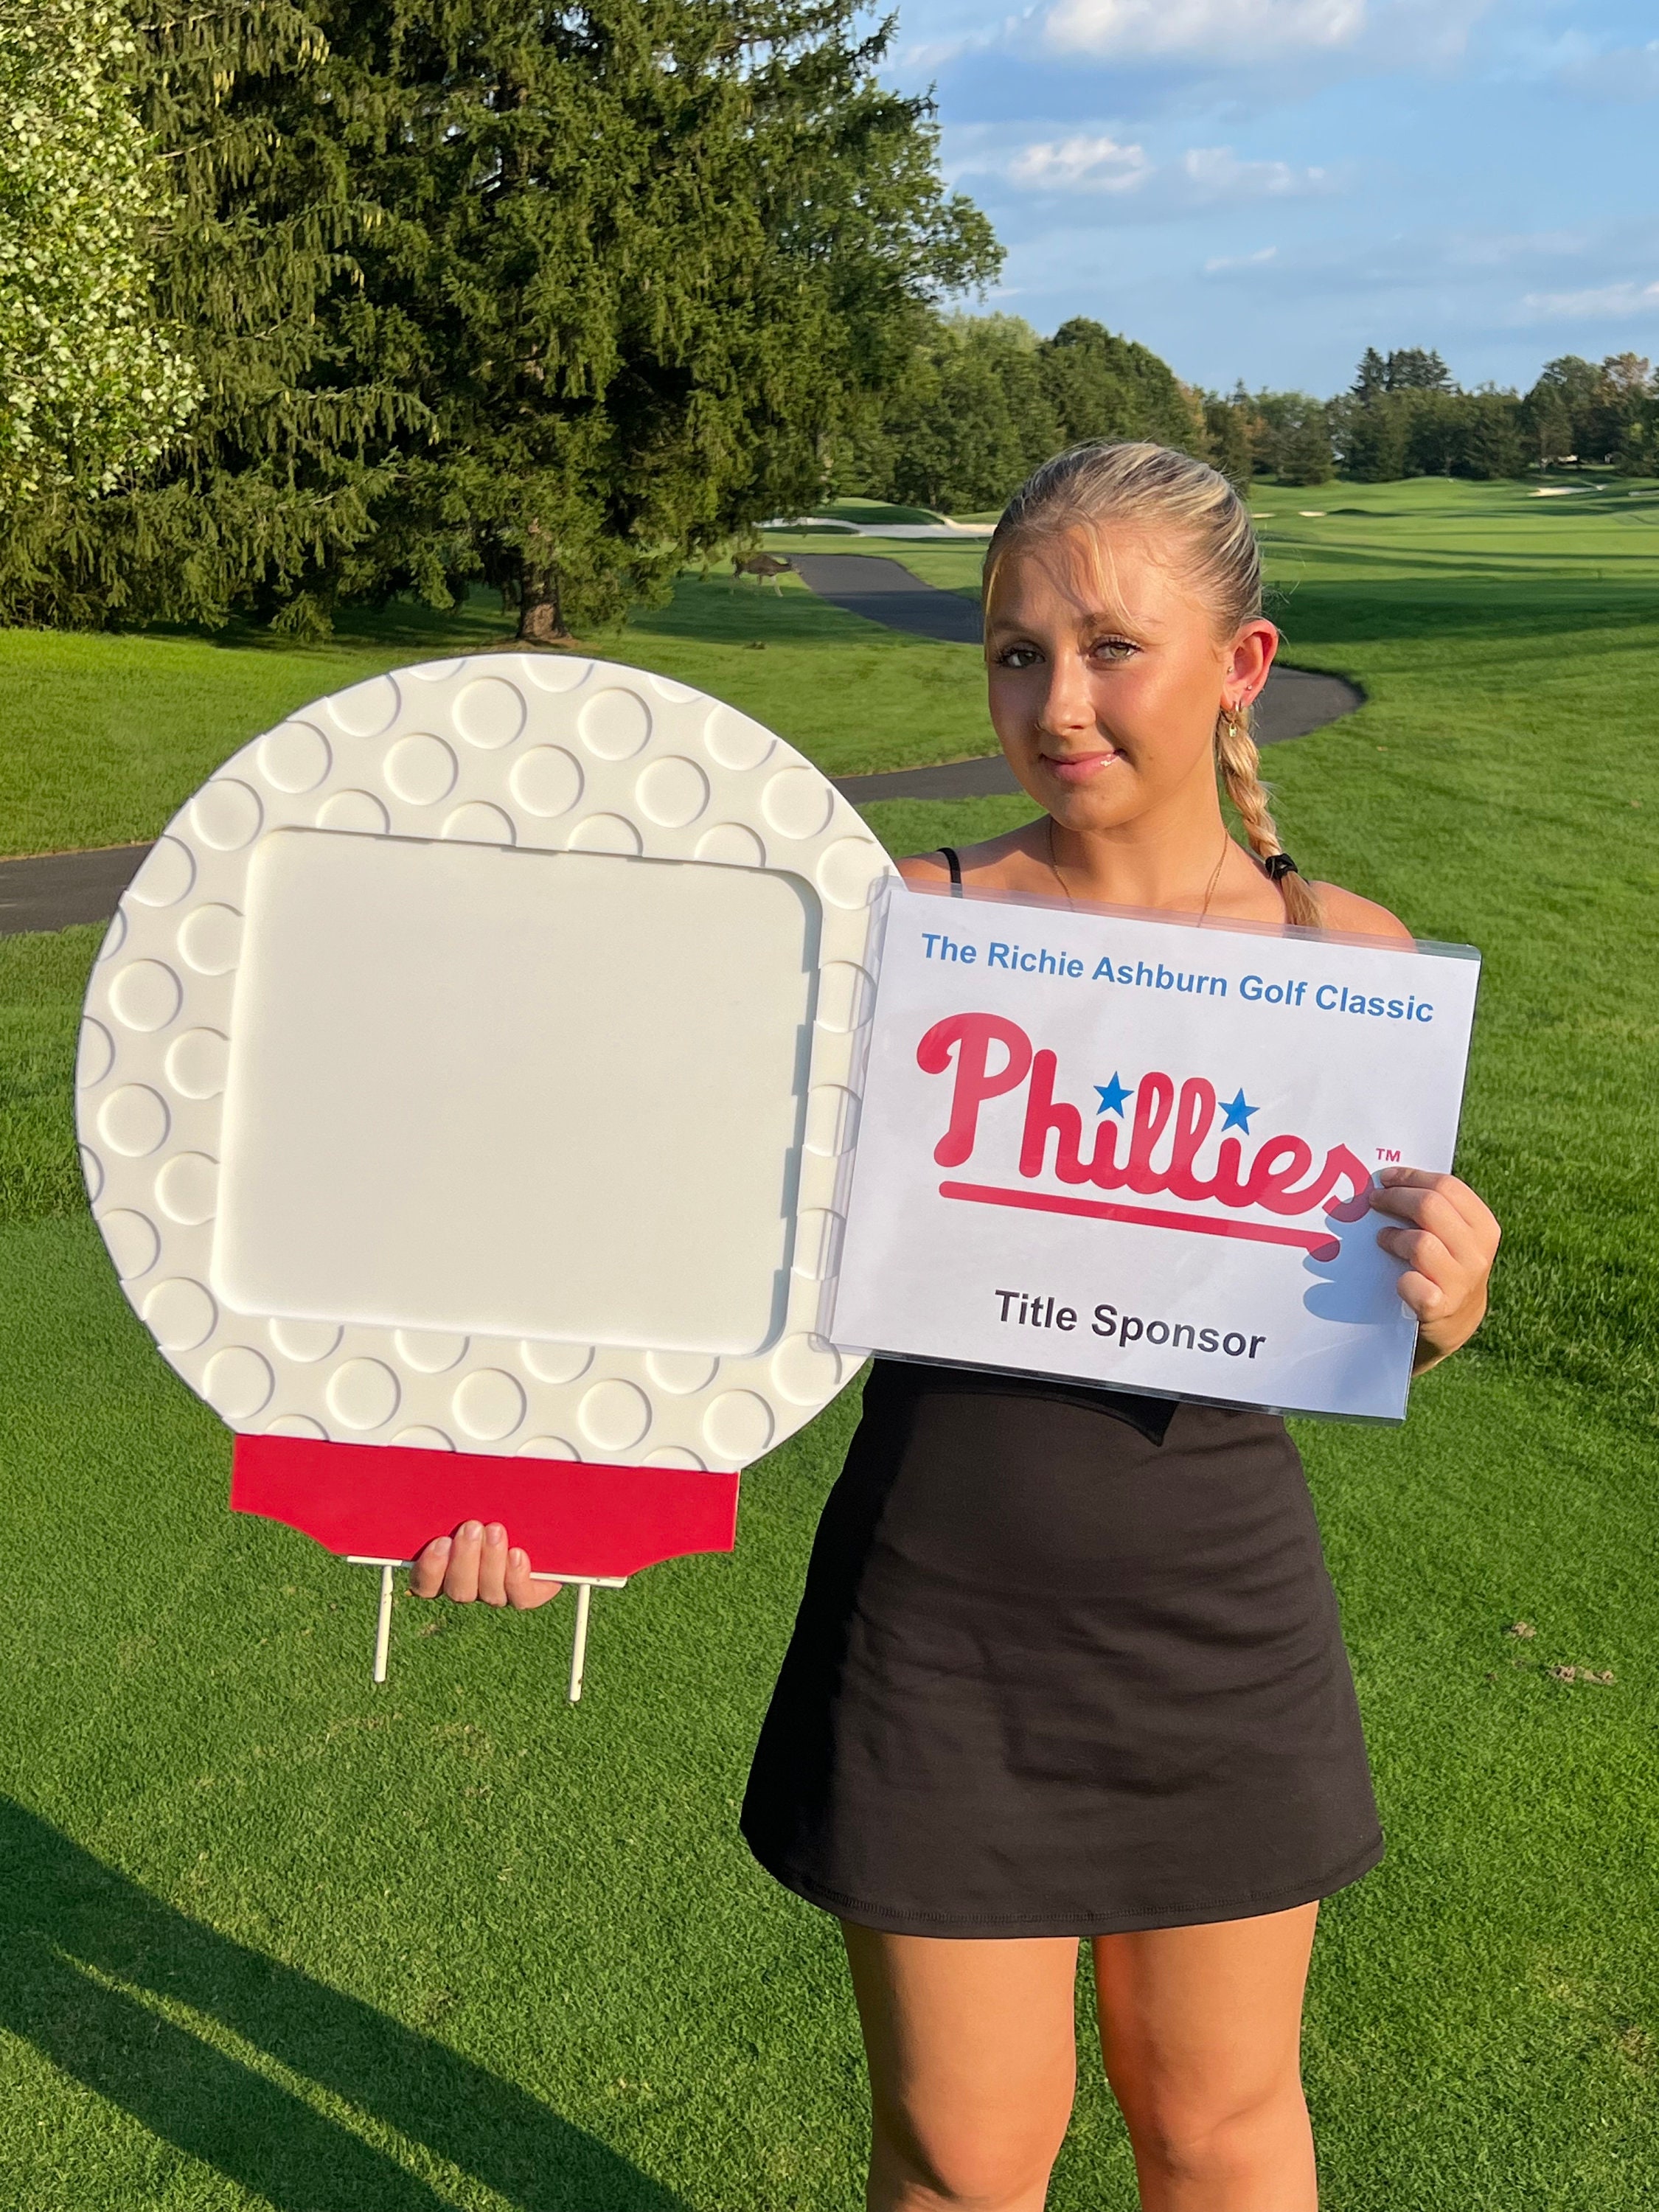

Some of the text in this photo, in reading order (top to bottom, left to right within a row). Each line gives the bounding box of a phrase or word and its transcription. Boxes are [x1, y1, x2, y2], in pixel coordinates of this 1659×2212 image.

[922, 933, 1434, 1022] The Richie Ashburn Golf Classic
[917, 1012, 1374, 1222] Phillies
[995, 1290, 1266, 1359] Title Sponsor
